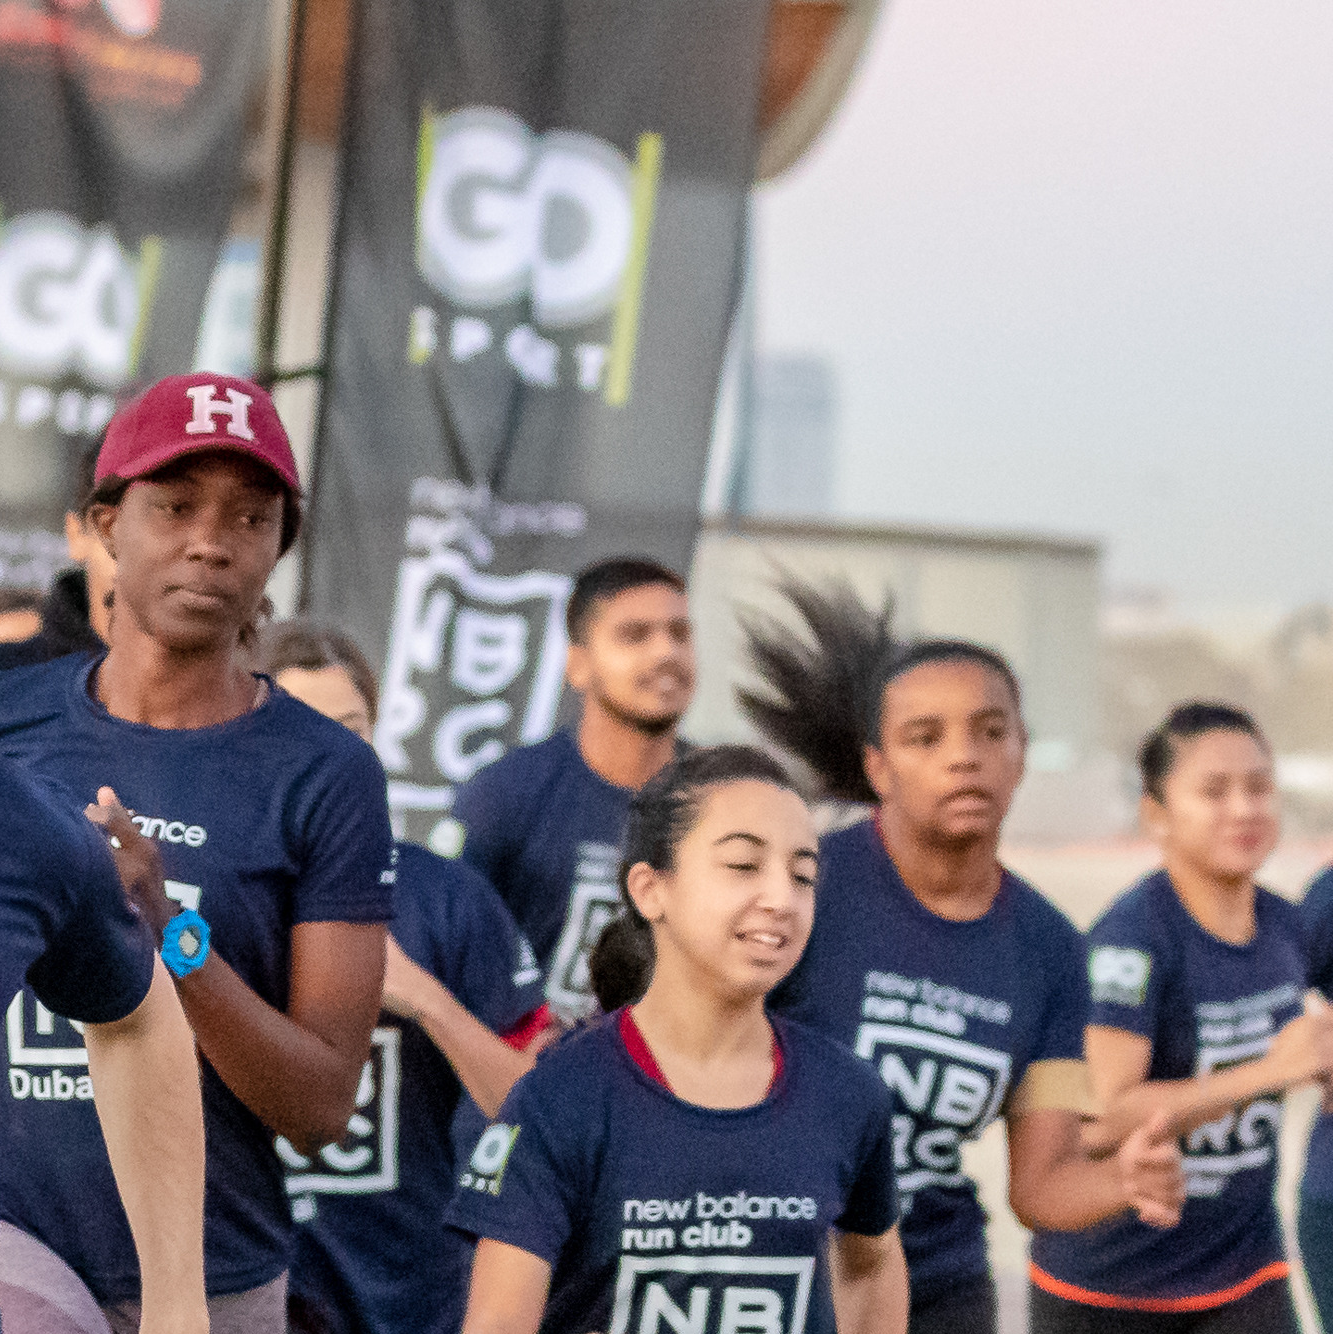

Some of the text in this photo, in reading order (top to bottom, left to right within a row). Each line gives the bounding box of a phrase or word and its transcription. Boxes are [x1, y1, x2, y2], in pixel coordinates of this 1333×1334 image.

[185, 384, 255, 441] H
[8, 1066, 95, 1100] Duba
[879, 1052, 992, 1128] NB
[623, 1191, 819, 1223] new balance
[621, 1219, 754, 1251] run club
